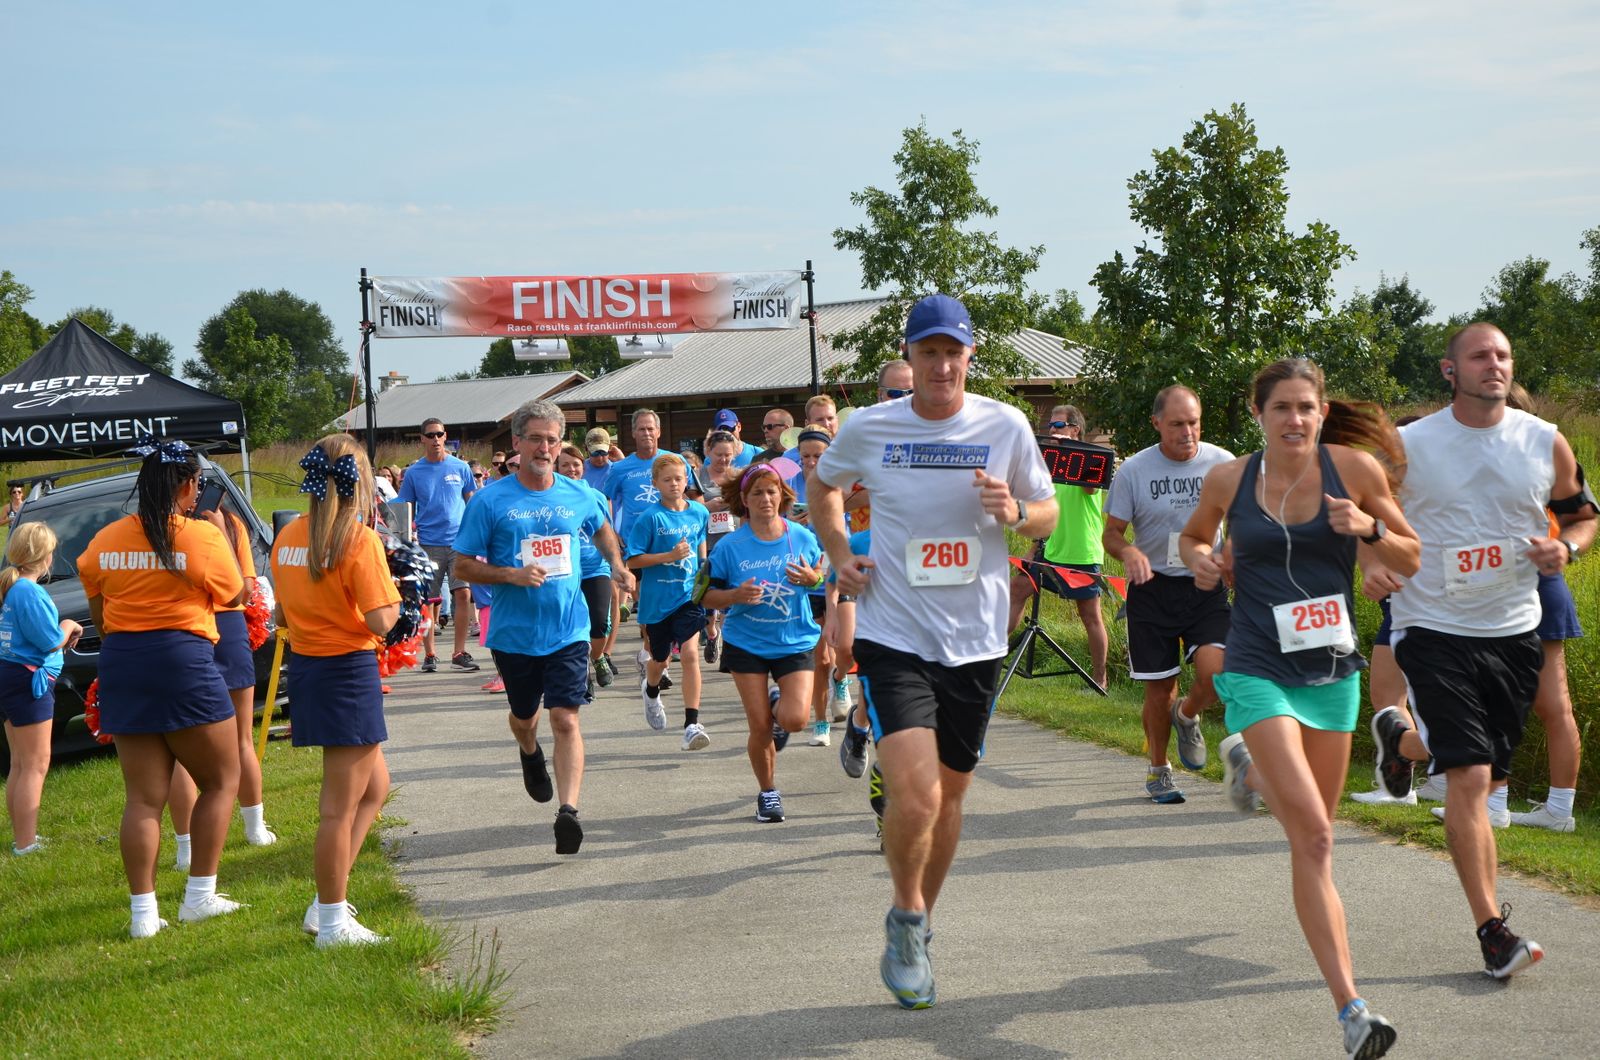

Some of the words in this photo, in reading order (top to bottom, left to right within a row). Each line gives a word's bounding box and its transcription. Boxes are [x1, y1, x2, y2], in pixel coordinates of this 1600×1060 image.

[379, 289, 434, 304] Franklin
[512, 279, 672, 320] FINISH
[734, 282, 786, 298] Franklin
[380, 305, 438, 327] FINISH
[733, 298, 787, 320] FINISH
[507, 323, 533, 332] Race
[535, 321, 570, 331] results
[573, 321, 584, 331] at
[586, 321, 677, 330] franklinfinish.com
[0, 376, 80, 394] FLEET
[84, 373, 150, 386] FEET
[1, 416, 171, 448] MOVEMENT
[913, 454, 985, 463] TRIATHLON
[1150, 476, 1171, 500] got
[1173, 476, 1203, 497] oxyg
[507, 507, 552, 522] Butterfly
[554, 505, 575, 518] Run
[711, 513, 728, 523] 343
[657, 524, 691, 536] Butterfly
[531, 538, 563, 558] 365
[921, 541, 969, 569] 260
[99, 552, 186, 570] VOLUNTR
[739, 555, 783, 572] Butterfly
[1457, 545, 1502, 573] 378
[1292, 600, 1341, 632] 259
